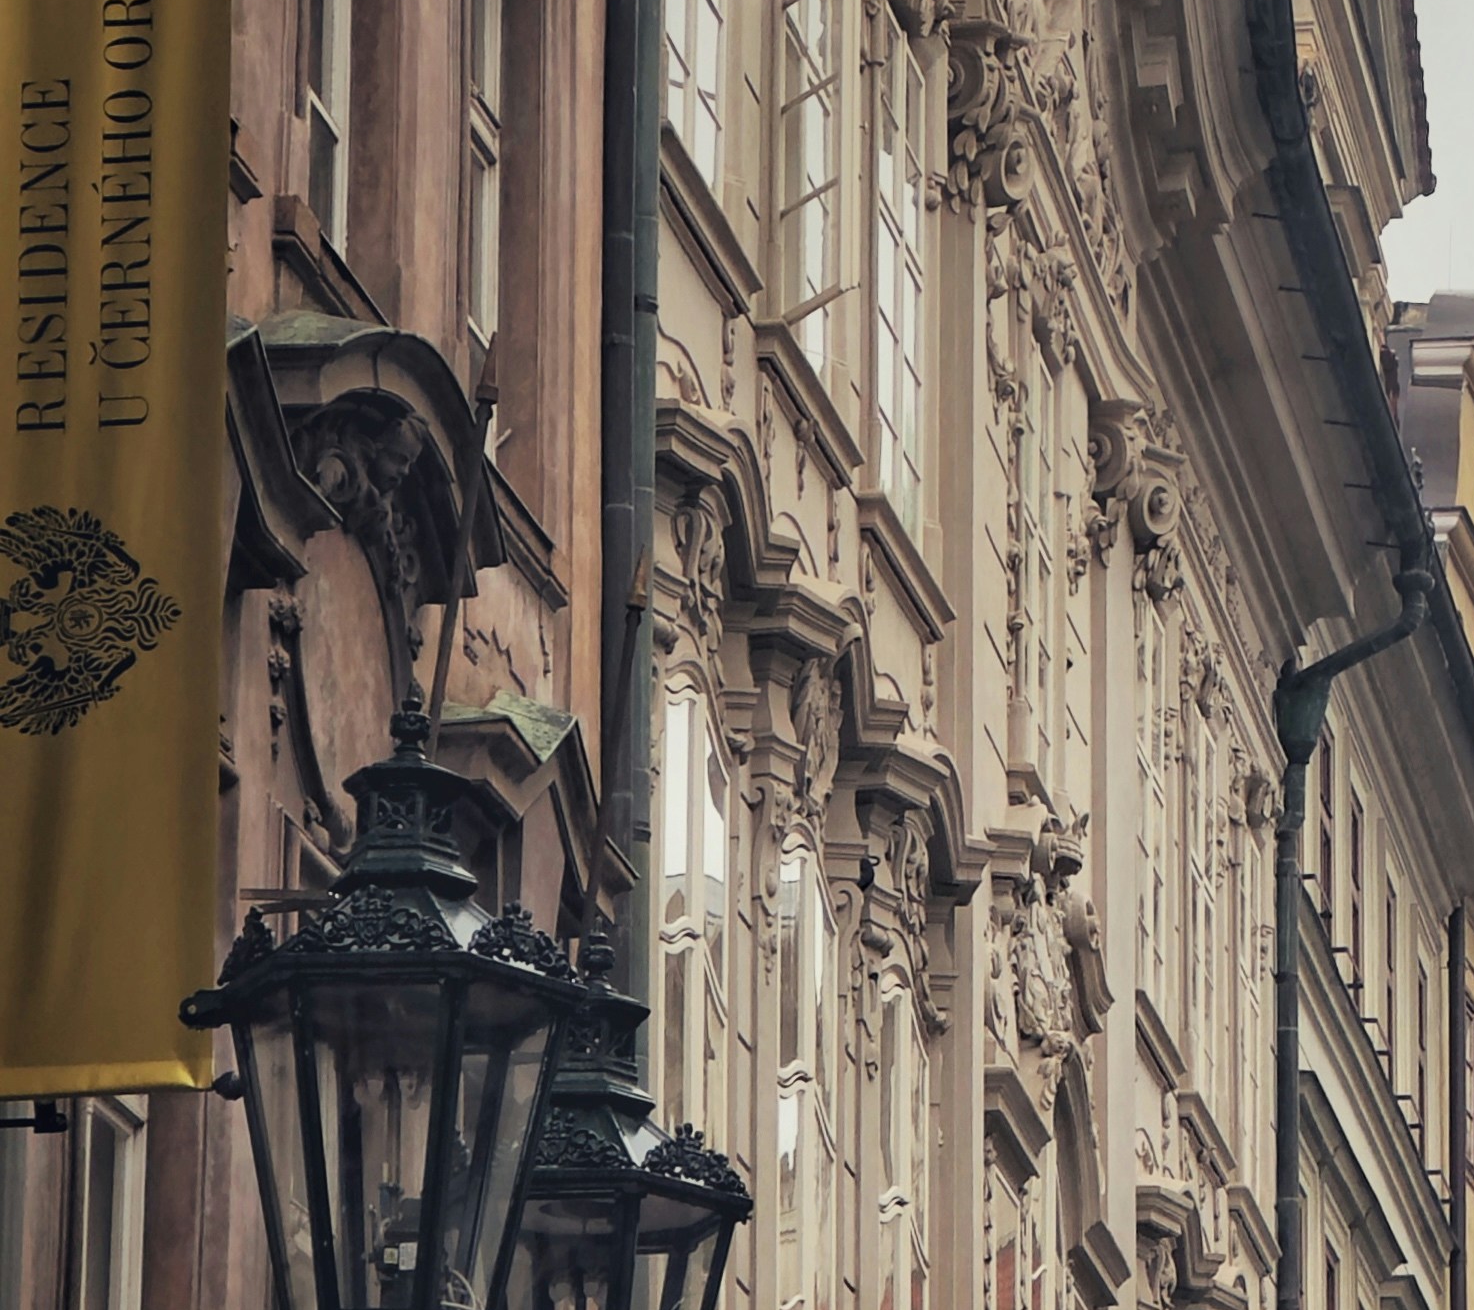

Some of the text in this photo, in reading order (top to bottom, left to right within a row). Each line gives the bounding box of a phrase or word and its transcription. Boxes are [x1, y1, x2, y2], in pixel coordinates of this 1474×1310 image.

[16, 78, 71, 434] RESIDENCE
[88, 89, 153, 370] ČERNÉHO
[98, 391, 150, 429] U
